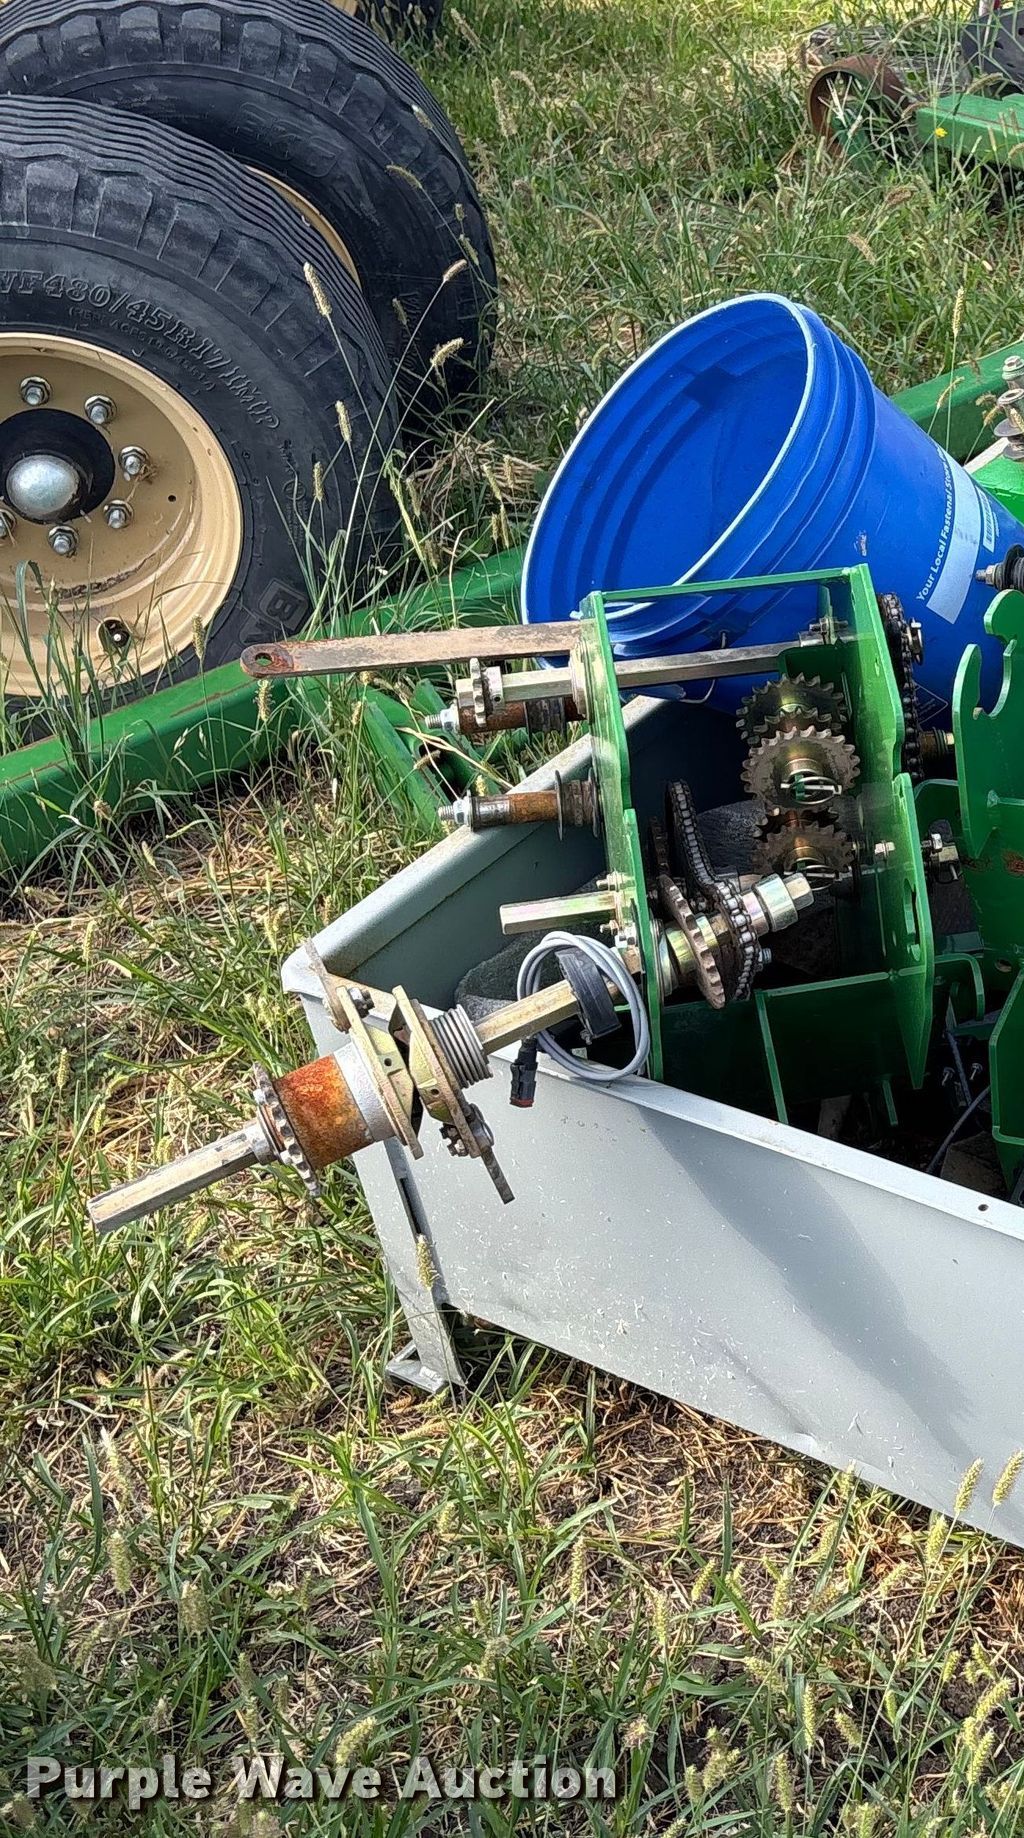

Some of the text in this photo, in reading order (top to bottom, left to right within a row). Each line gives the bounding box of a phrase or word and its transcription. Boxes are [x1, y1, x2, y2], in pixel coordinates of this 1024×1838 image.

[940, 488, 953, 540] Fastenal
[931, 539, 951, 578] Local
[916, 575, 939, 601] Your
